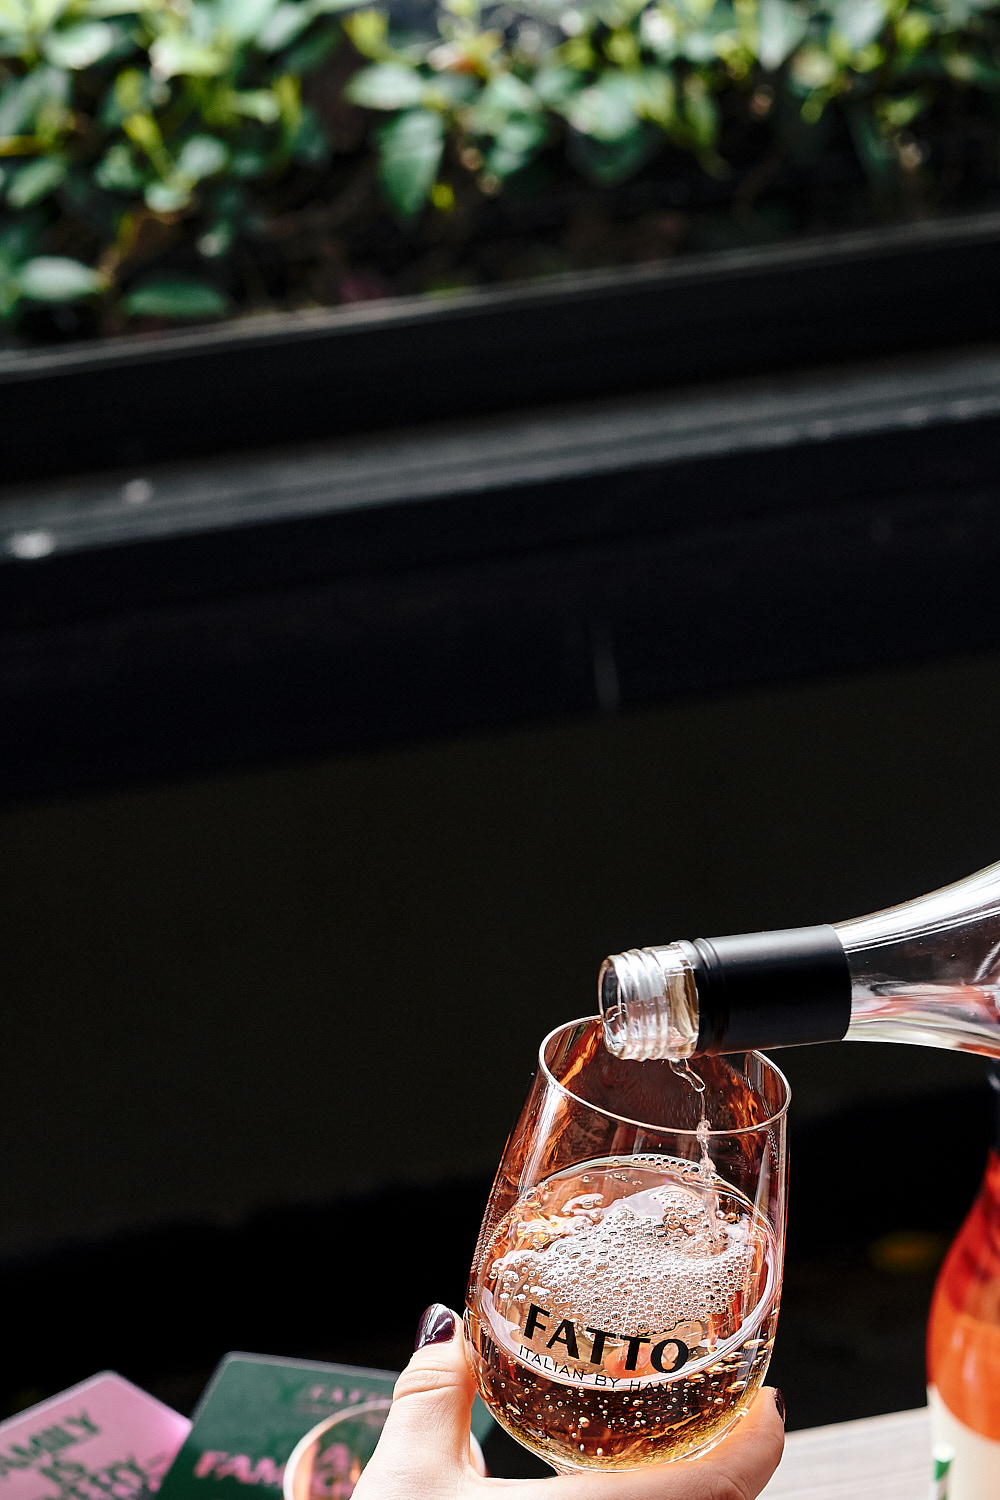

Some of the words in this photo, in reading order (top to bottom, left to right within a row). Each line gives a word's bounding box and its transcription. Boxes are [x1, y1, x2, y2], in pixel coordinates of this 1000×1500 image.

[518, 1344, 586, 1381] ITALIAN
[594, 1374, 621, 1389] BY
[523, 1303, 690, 1374] FATTO
